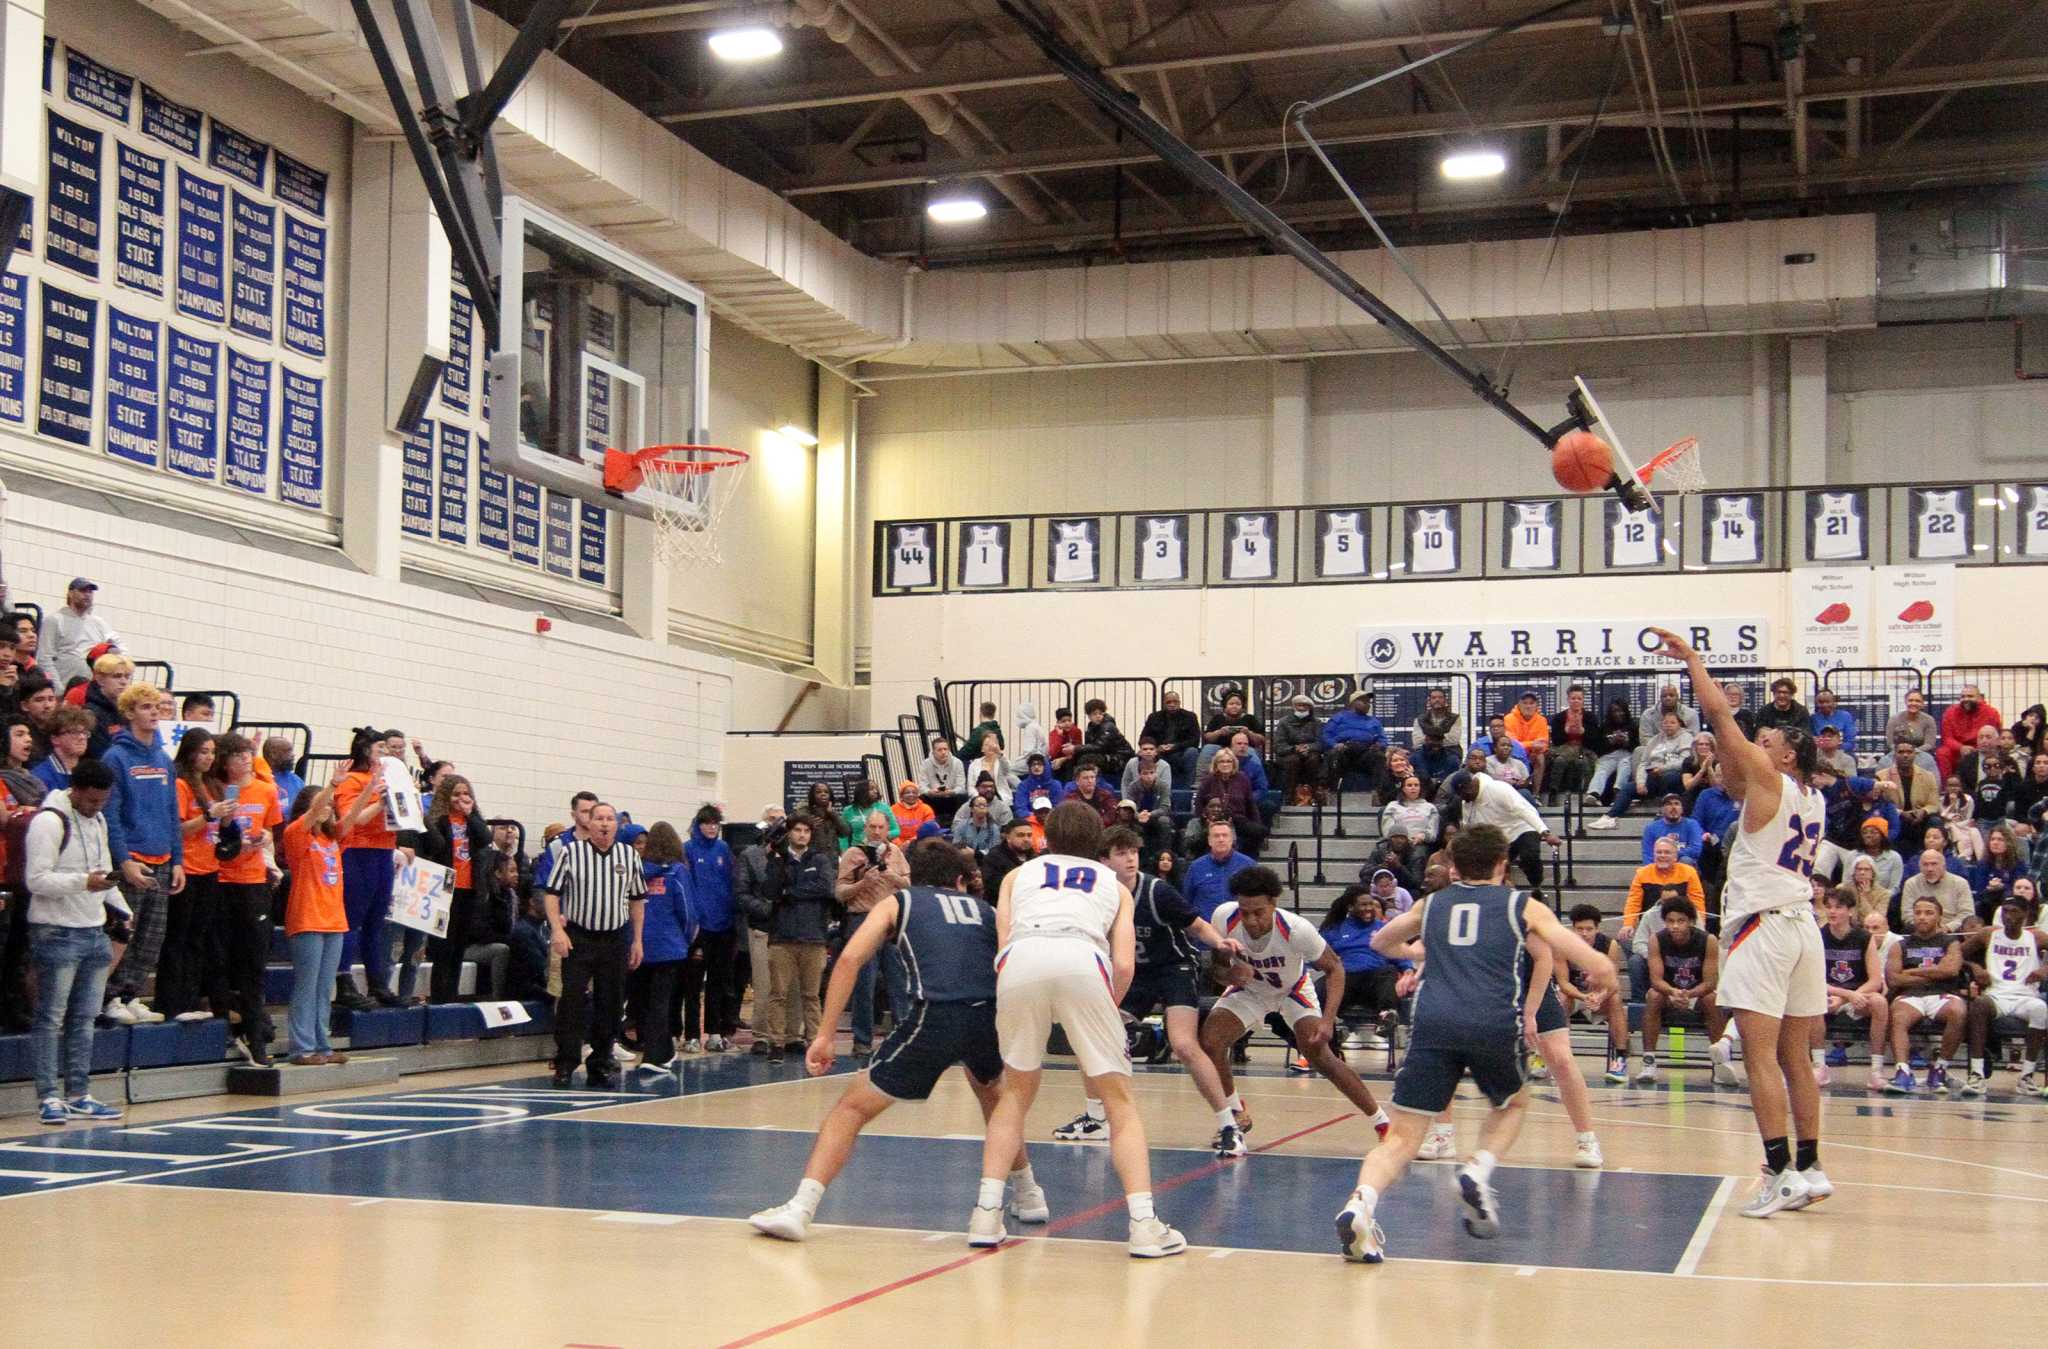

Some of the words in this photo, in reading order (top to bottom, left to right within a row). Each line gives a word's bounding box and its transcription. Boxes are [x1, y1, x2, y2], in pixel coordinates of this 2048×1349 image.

[56, 126, 95, 154] WILTON
[124, 150, 159, 173] WILTON
[59, 182, 89, 204] 1991
[127, 186, 155, 207] 1991
[184, 179, 218, 202] WILTON
[239, 203, 269, 226] WILTON
[122, 221, 150, 243] CLASS
[186, 221, 216, 242] 1990
[293, 223, 319, 243] WILTON
[126, 242, 154, 267] STATE
[177, 287, 224, 317] CHAMPIONS
[237, 282, 266, 307] STATE
[51, 300, 88, 323] WILTON
[291, 305, 318, 329] STATE
[65, 331, 90, 349] SCHOOL
[117, 319, 153, 341] WILTON
[129, 345, 155, 361] SCHOOL
[177, 337, 212, 358] WILTON
[52, 354, 82, 373] 1991
[119, 361, 147, 381] 1991
[235, 356, 264, 376] WILTON
[290, 376, 316, 394] WILTON
[117, 404, 146, 429] STATE
[169, 407, 203, 428] CLASS
[205, 418, 212, 431] L
[232, 416, 263, 436] SOCCER
[177, 428, 204, 450] STATE
[292, 422, 313, 437] BOYS
[109, 426, 158, 456] CHAMPIONS
[287, 434, 317, 453] SOCCER
[234, 448, 261, 470] STATE
[290, 465, 313, 485] STATE
[406, 495, 427, 513] STATE
[445, 501, 463, 518] STATE
[517, 522, 535, 539] STATE
[1626, 523, 1645, 543] 12
[1723, 520, 1744, 540] 14
[1826, 516, 1848, 536] 21
[1928, 514, 1955, 534] 22
[1337, 534, 1349, 552] 5
[1423, 531, 1443, 549] 10
[1525, 527, 1540, 545] 11
[900, 547, 924, 565] 44
[981, 546, 988, 564] 1
[1068, 543, 1079, 560] 2
[1156, 540, 1167, 558] 3
[1244, 538, 1256, 556] 4
[1412, 625, 1757, 657] WARRIORS
[1805, 646, 1828, 654] 2016
[1836, 645, 1859, 654] 2019
[1413, 659, 1465, 669] WILTON
[1471, 658, 1505, 668] HIGH
[1512, 657, 1570, 667] SCHOOL
[1577, 656, 1621, 666] TRACK
[1627, 656, 1636, 665] &
[1643, 655, 1682, 665] FIELD
[1699, 654, 1758, 664] ECORDS
[1777, 813, 1821, 877] 23
[934, 893, 983, 926] 10
[1448, 903, 1480, 946] 0
[2003, 960, 2017, 981] 2
